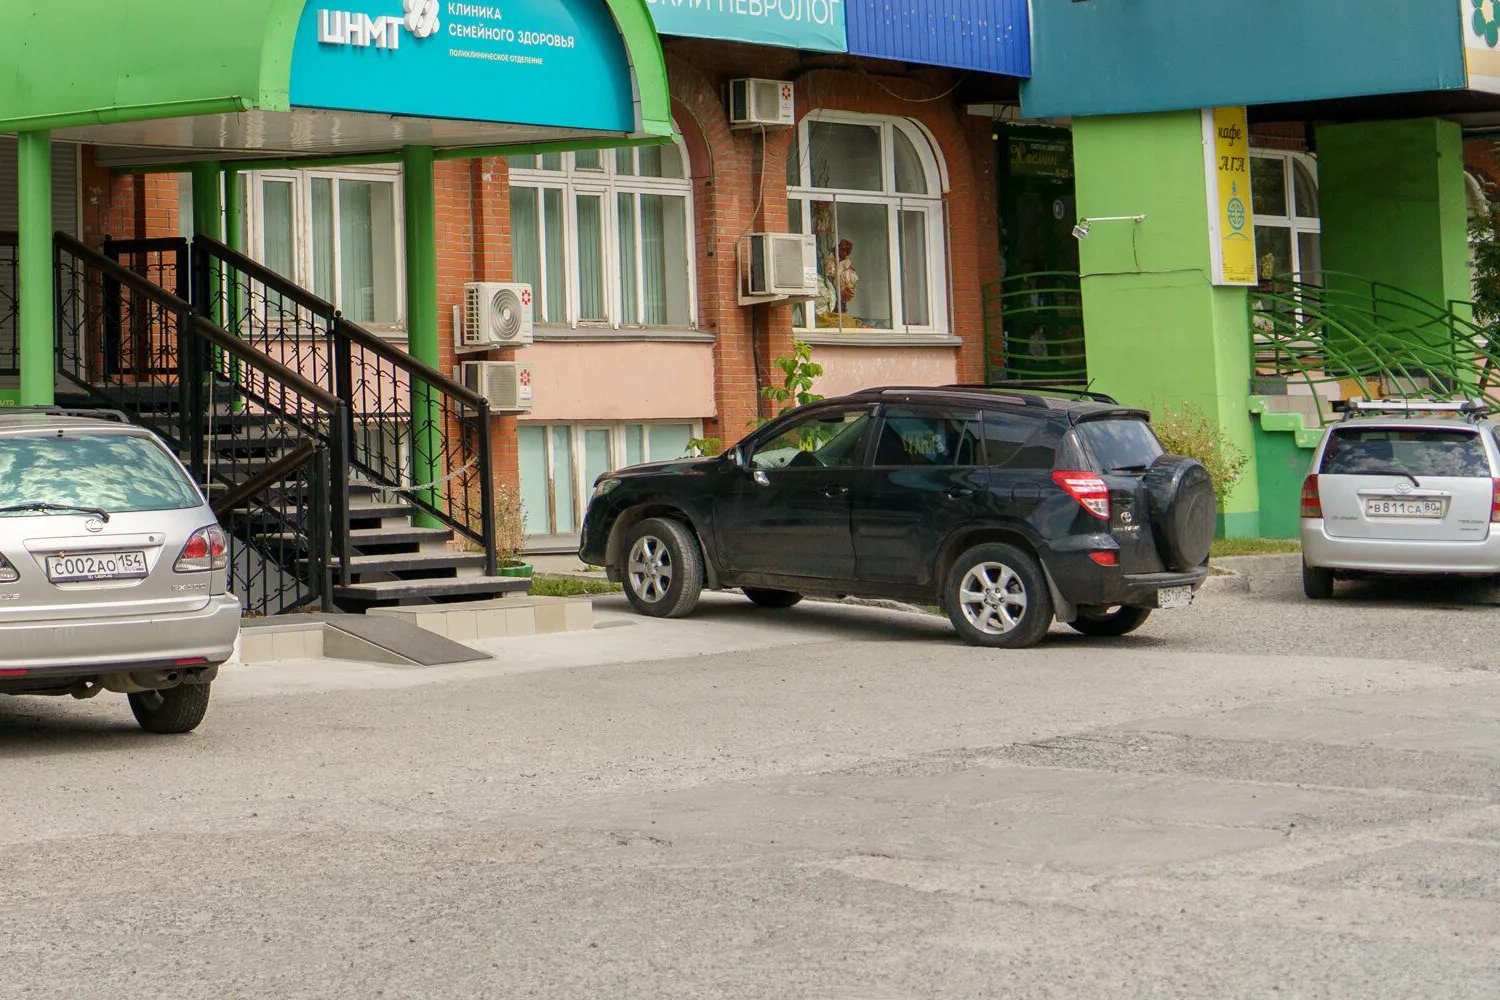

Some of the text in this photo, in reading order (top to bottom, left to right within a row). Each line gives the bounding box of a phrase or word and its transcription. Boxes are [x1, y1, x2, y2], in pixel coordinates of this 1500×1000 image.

[448, 2, 502, 20] КЛИНИКА
[318, 9, 404, 50] ЦНМТ
[449, 23, 574, 49] СЕМЕЙНОГО ЗДОРОВЬЯ
[449, 49, 543, 65] ПОЛИКЛИНИЧЕСКОЕ ОТДЕЛЕНИЕ
[1218, 123, 1242, 146] кафе
[118, 554, 141, 567] 154
